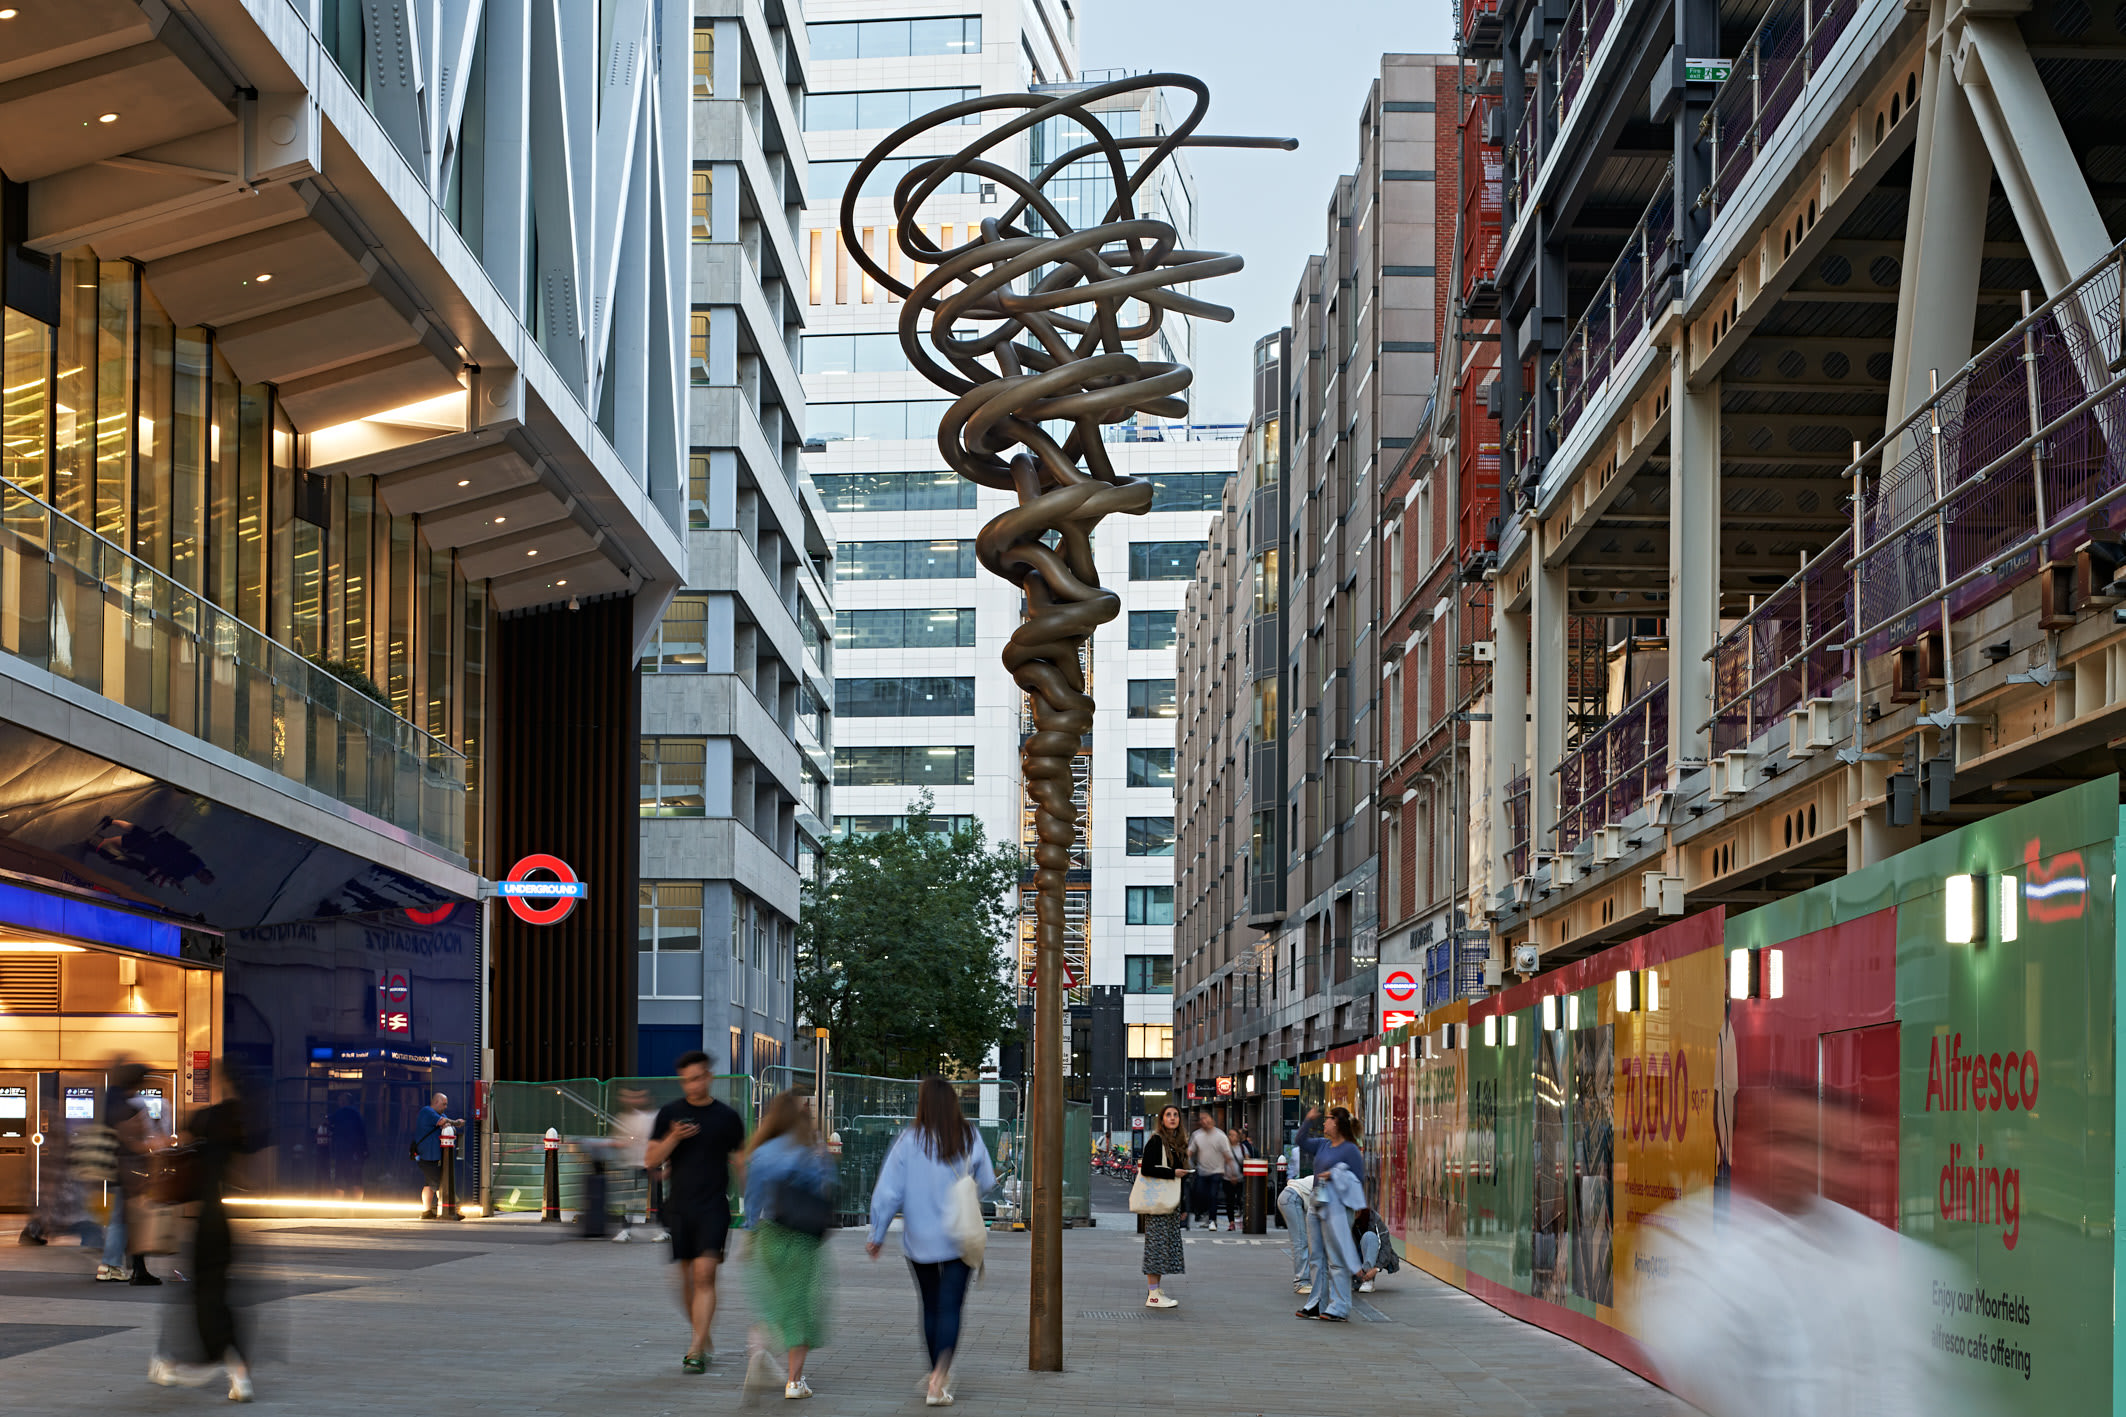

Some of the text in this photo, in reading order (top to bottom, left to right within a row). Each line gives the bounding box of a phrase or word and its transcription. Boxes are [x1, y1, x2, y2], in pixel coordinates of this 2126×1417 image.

[1889, 615, 1911, 644] BHC
[504, 884, 578, 895] UNDERGROUND
[1622, 1049, 1689, 1151] 70,000
[1925, 1032, 2039, 1112] Alfresco
[1939, 1143, 2020, 1250] dining
[1932, 1279, 2030, 1326] Enjoy our Moorfields
[1931, 1322, 2031, 1381] alfresco café offering
